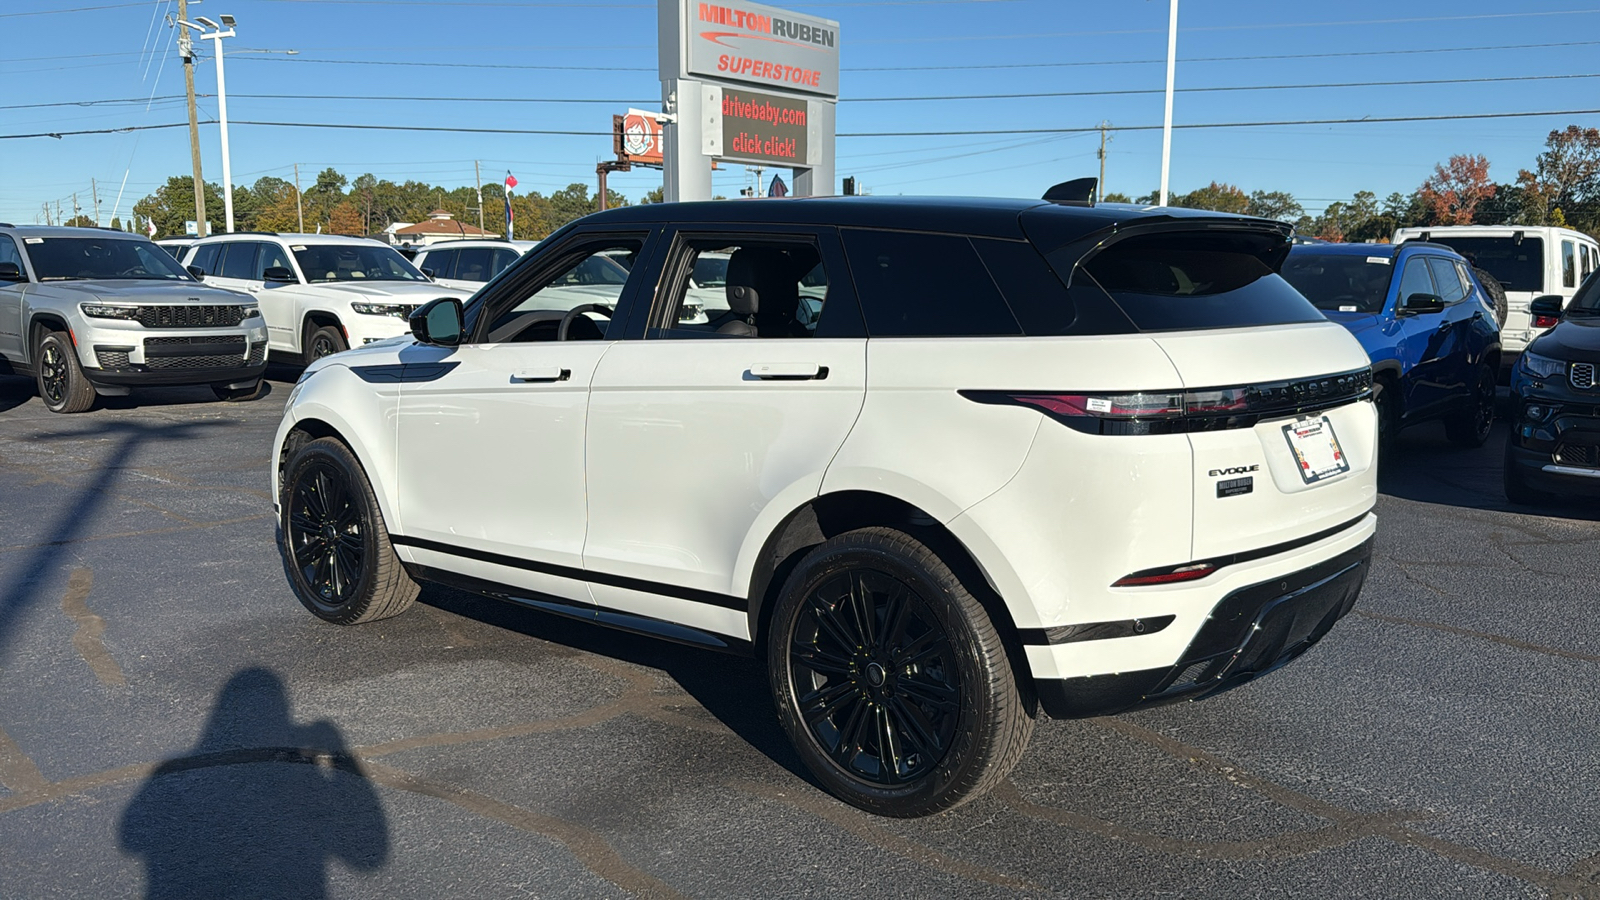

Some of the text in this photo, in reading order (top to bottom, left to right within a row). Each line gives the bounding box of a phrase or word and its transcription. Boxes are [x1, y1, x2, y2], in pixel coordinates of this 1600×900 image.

[698, 2, 835, 48] MILTON RUBEN
[717, 54, 822, 87] SUPERSTORE
[722, 95, 806, 127] drivebaby.com
[732, 133, 796, 158] click click!
[1259, 380, 1329, 401] RANGE
[1208, 464, 1260, 477] EVOQUE
[1219, 480, 1237, 490] MILTON
